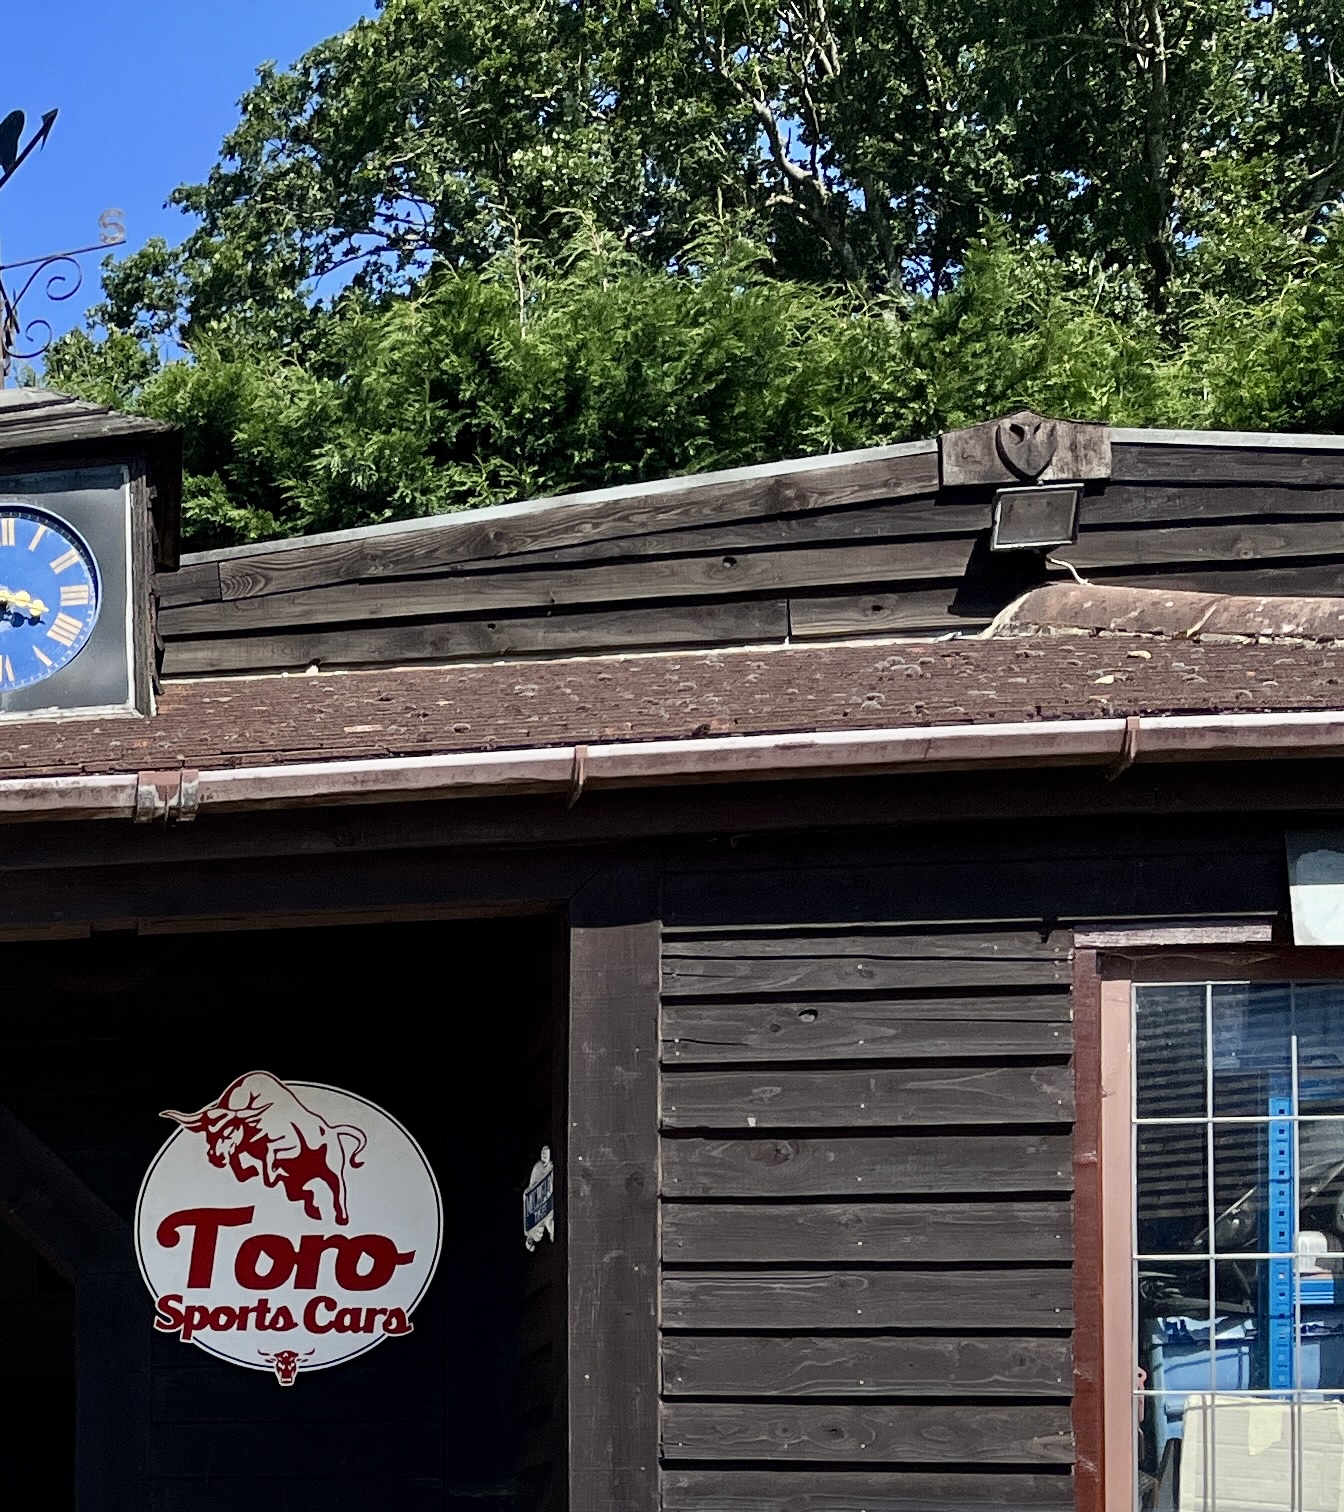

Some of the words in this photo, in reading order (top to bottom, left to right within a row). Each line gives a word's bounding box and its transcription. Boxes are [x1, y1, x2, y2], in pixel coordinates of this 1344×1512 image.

[98, 208, 125, 243] S
[28, 523, 48, 552] I
[49, 548, 80, 575] II
[60, 585, 89, 607] III
[156, 1205, 416, 1291] Toro
[154, 1294, 298, 1340] Sports
[303, 1296, 414, 1334] Cars
